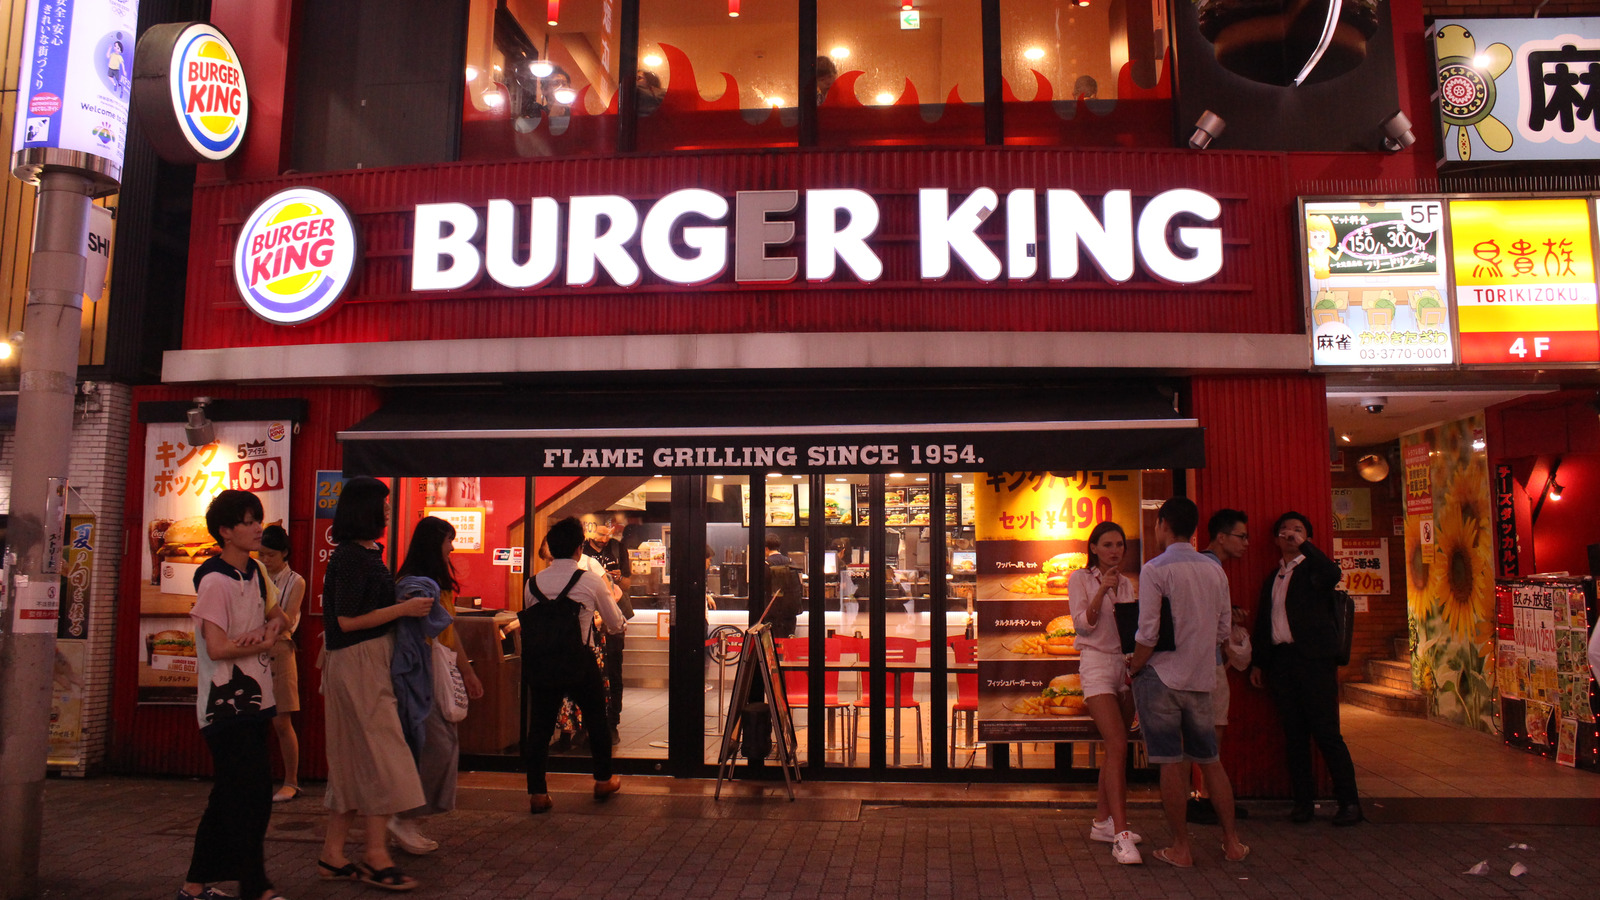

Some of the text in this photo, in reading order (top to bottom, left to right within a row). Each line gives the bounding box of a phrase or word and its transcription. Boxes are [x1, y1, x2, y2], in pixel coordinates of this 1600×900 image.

[35, 4, 52, 91] きれいな街づくり
[188, 61, 240, 87] BURGER
[81, 102, 116, 119] Welcome
[186, 84, 242, 116] KING
[1410, 204, 1439, 223] 5F
[251, 218, 335, 256] BURGER
[411, 186, 1223, 291] BURGER KING
[250, 238, 335, 288] KING
[1472, 238, 1576, 278] 鳥貴族
[1473, 287, 1579, 303] TORIKIZOKU
[1317, 334, 1352, 351] 麻雀
[1359, 348, 1448, 360] 03-3770-0001
[155, 439, 221, 468] キング
[237, 444, 247, 459] 5
[543, 444, 985, 468] FLAME GRILLING SINCE 1954.
[153, 469, 229, 498] ボックス
[231, 460, 280, 491] ¥690
[318, 499, 337, 508] OP
[999, 496, 1113, 530] セット ¥490
[1497, 465, 1517, 577] チーズダッカルビ
[68, 523, 95, 637] 夏の旬を握る
[1513, 589, 1553, 608] 飲み放題
[994, 619, 1030, 627] タルタルチキン
[987, 679, 1030, 687] フィッシュバーガー
